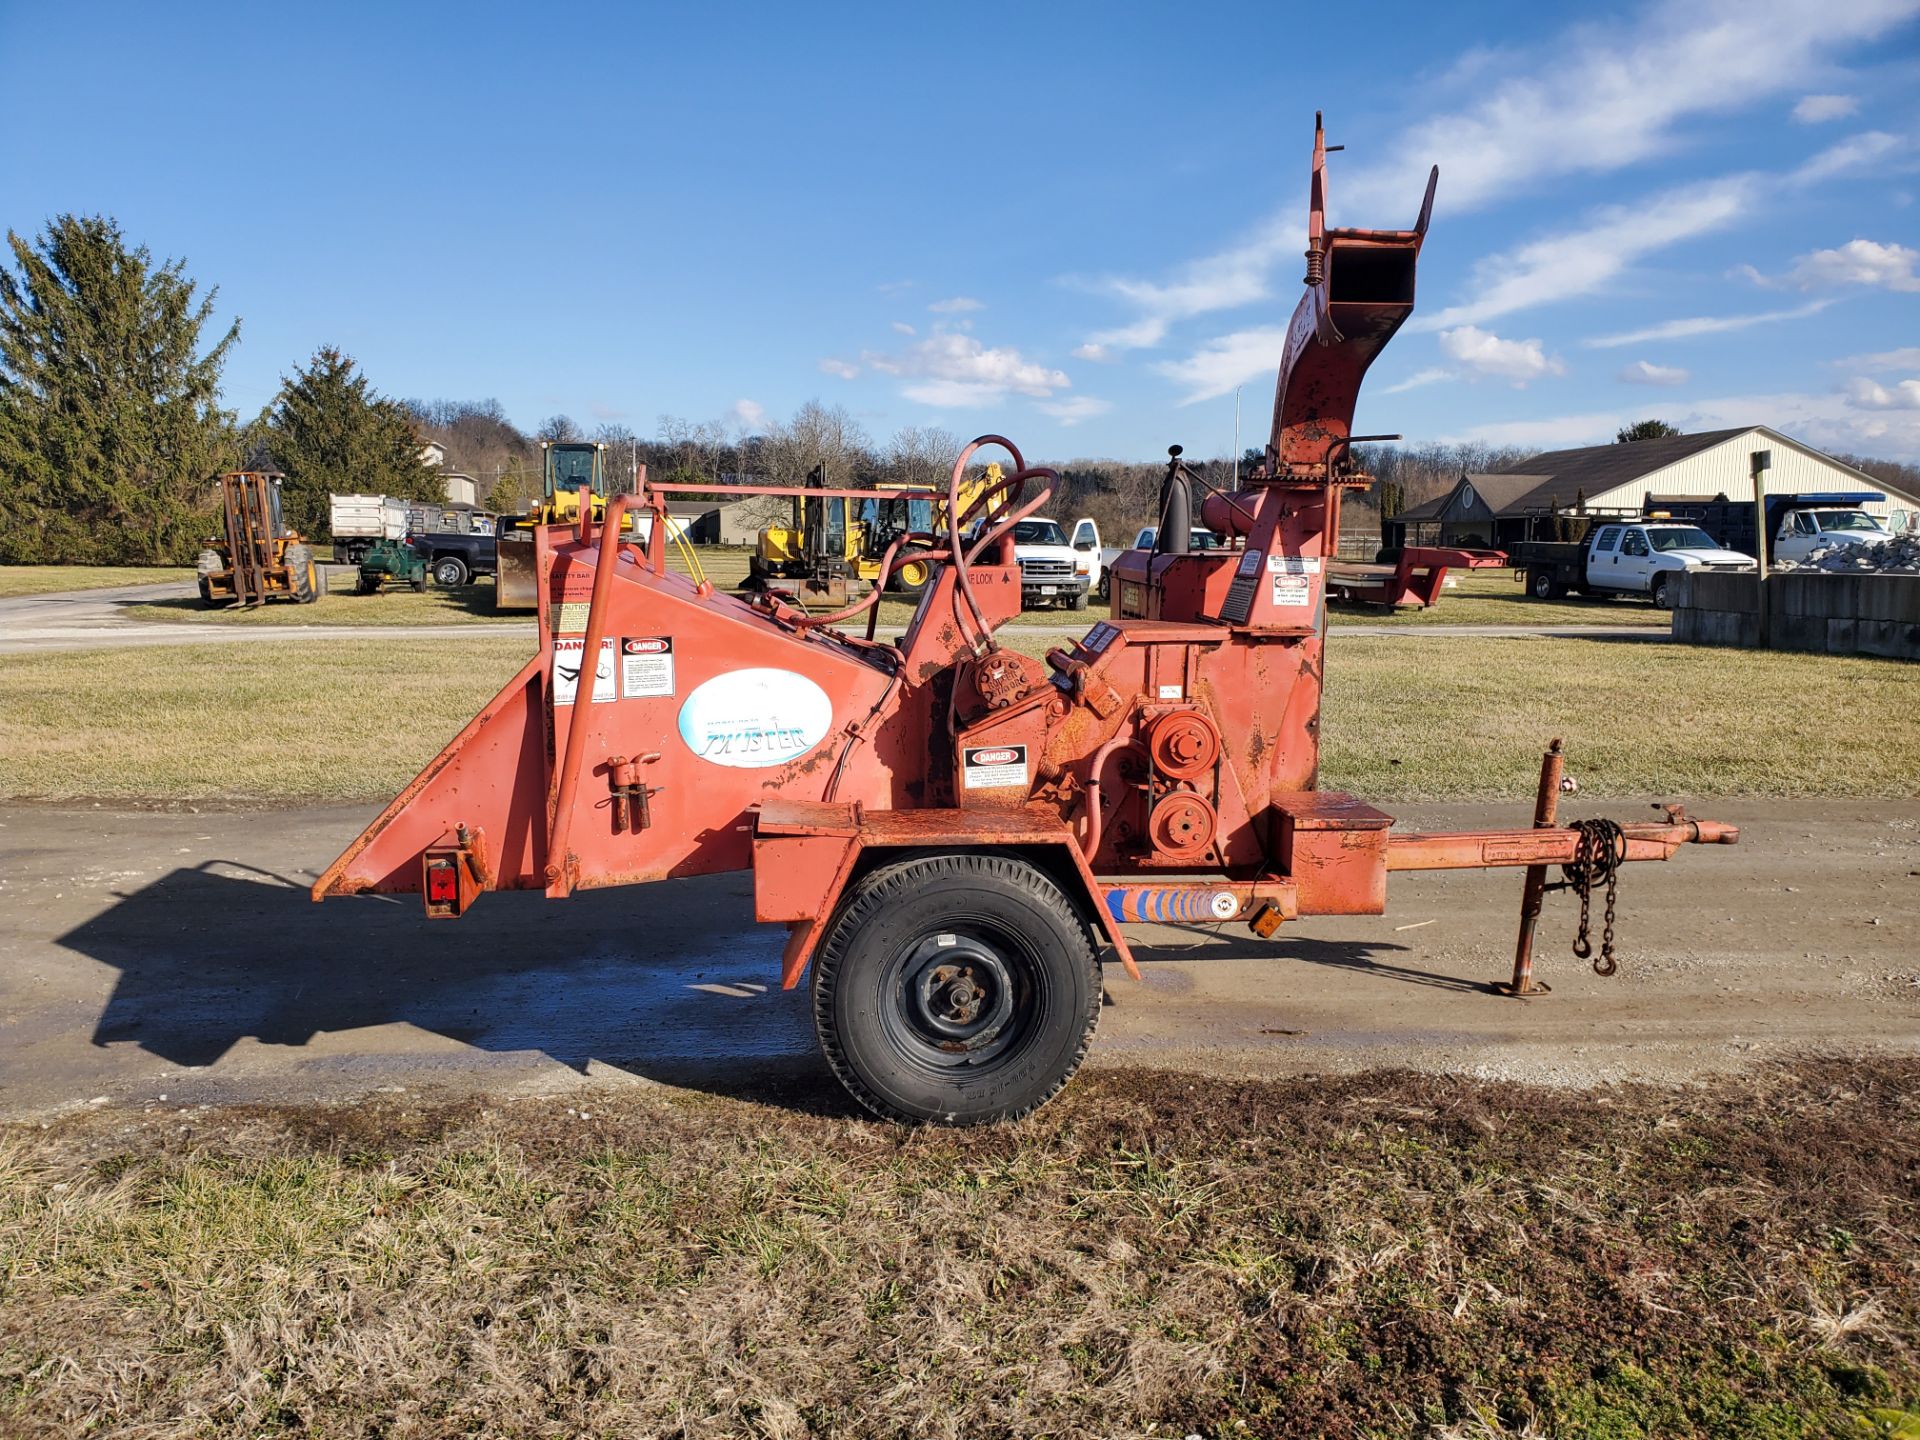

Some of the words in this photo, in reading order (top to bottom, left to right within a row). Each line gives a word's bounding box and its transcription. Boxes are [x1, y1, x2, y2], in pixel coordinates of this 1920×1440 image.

[976, 573, 993, 585] LOCK
[555, 641, 612, 651] DANR!
[632, 641, 662, 651] DANGER
[980, 751, 1011, 762] DANGER
